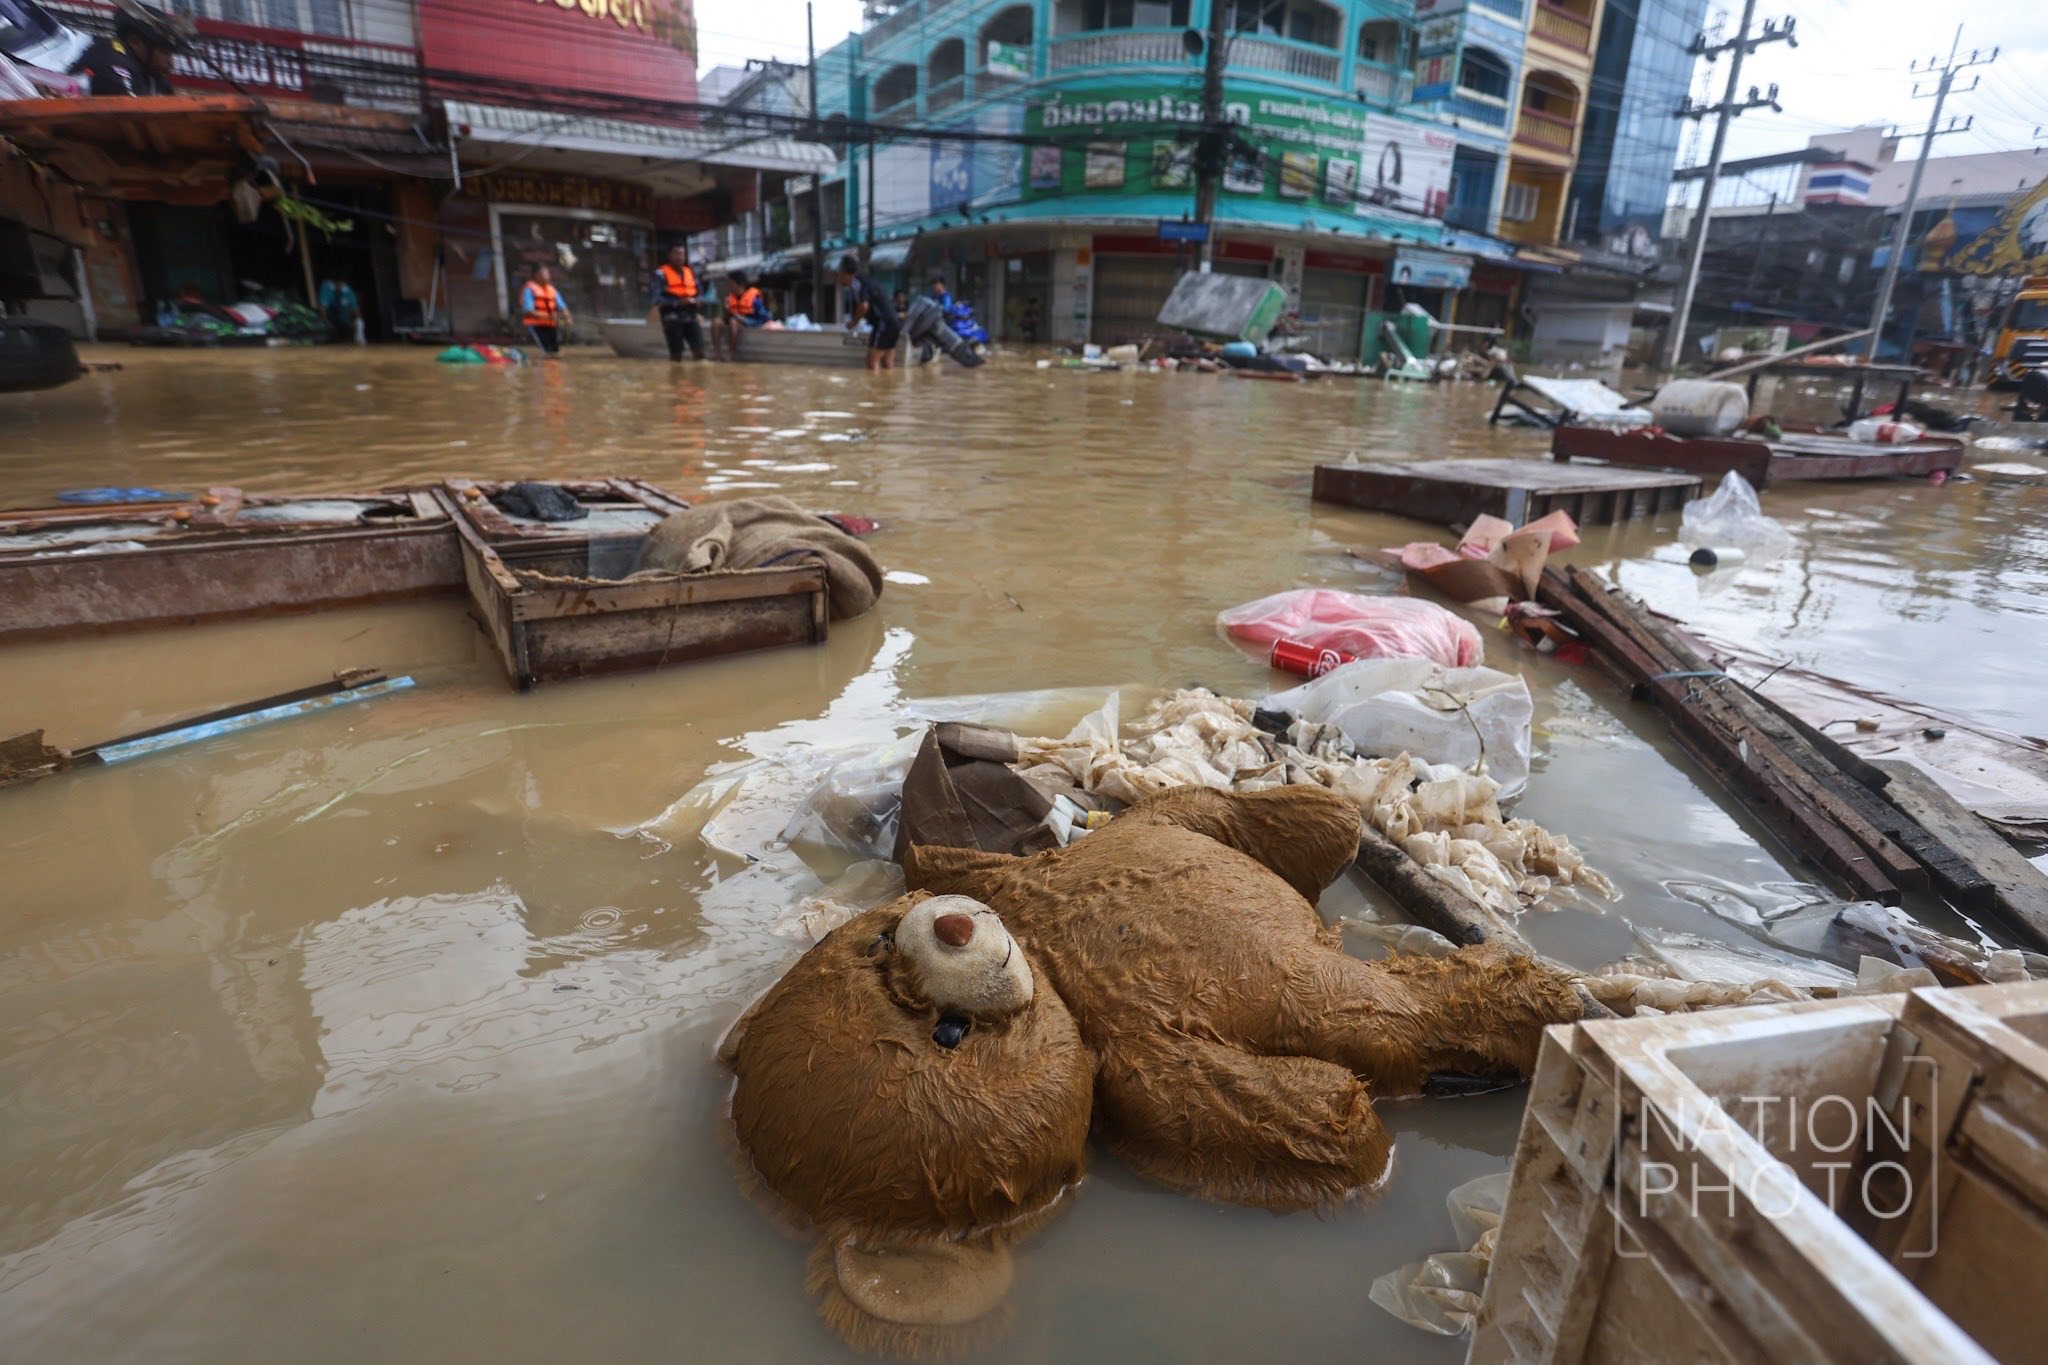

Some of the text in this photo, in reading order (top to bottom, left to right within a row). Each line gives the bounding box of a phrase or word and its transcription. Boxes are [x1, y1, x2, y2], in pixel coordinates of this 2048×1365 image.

[1043, 91, 1251, 134] อิ่มอุดมโอถ
